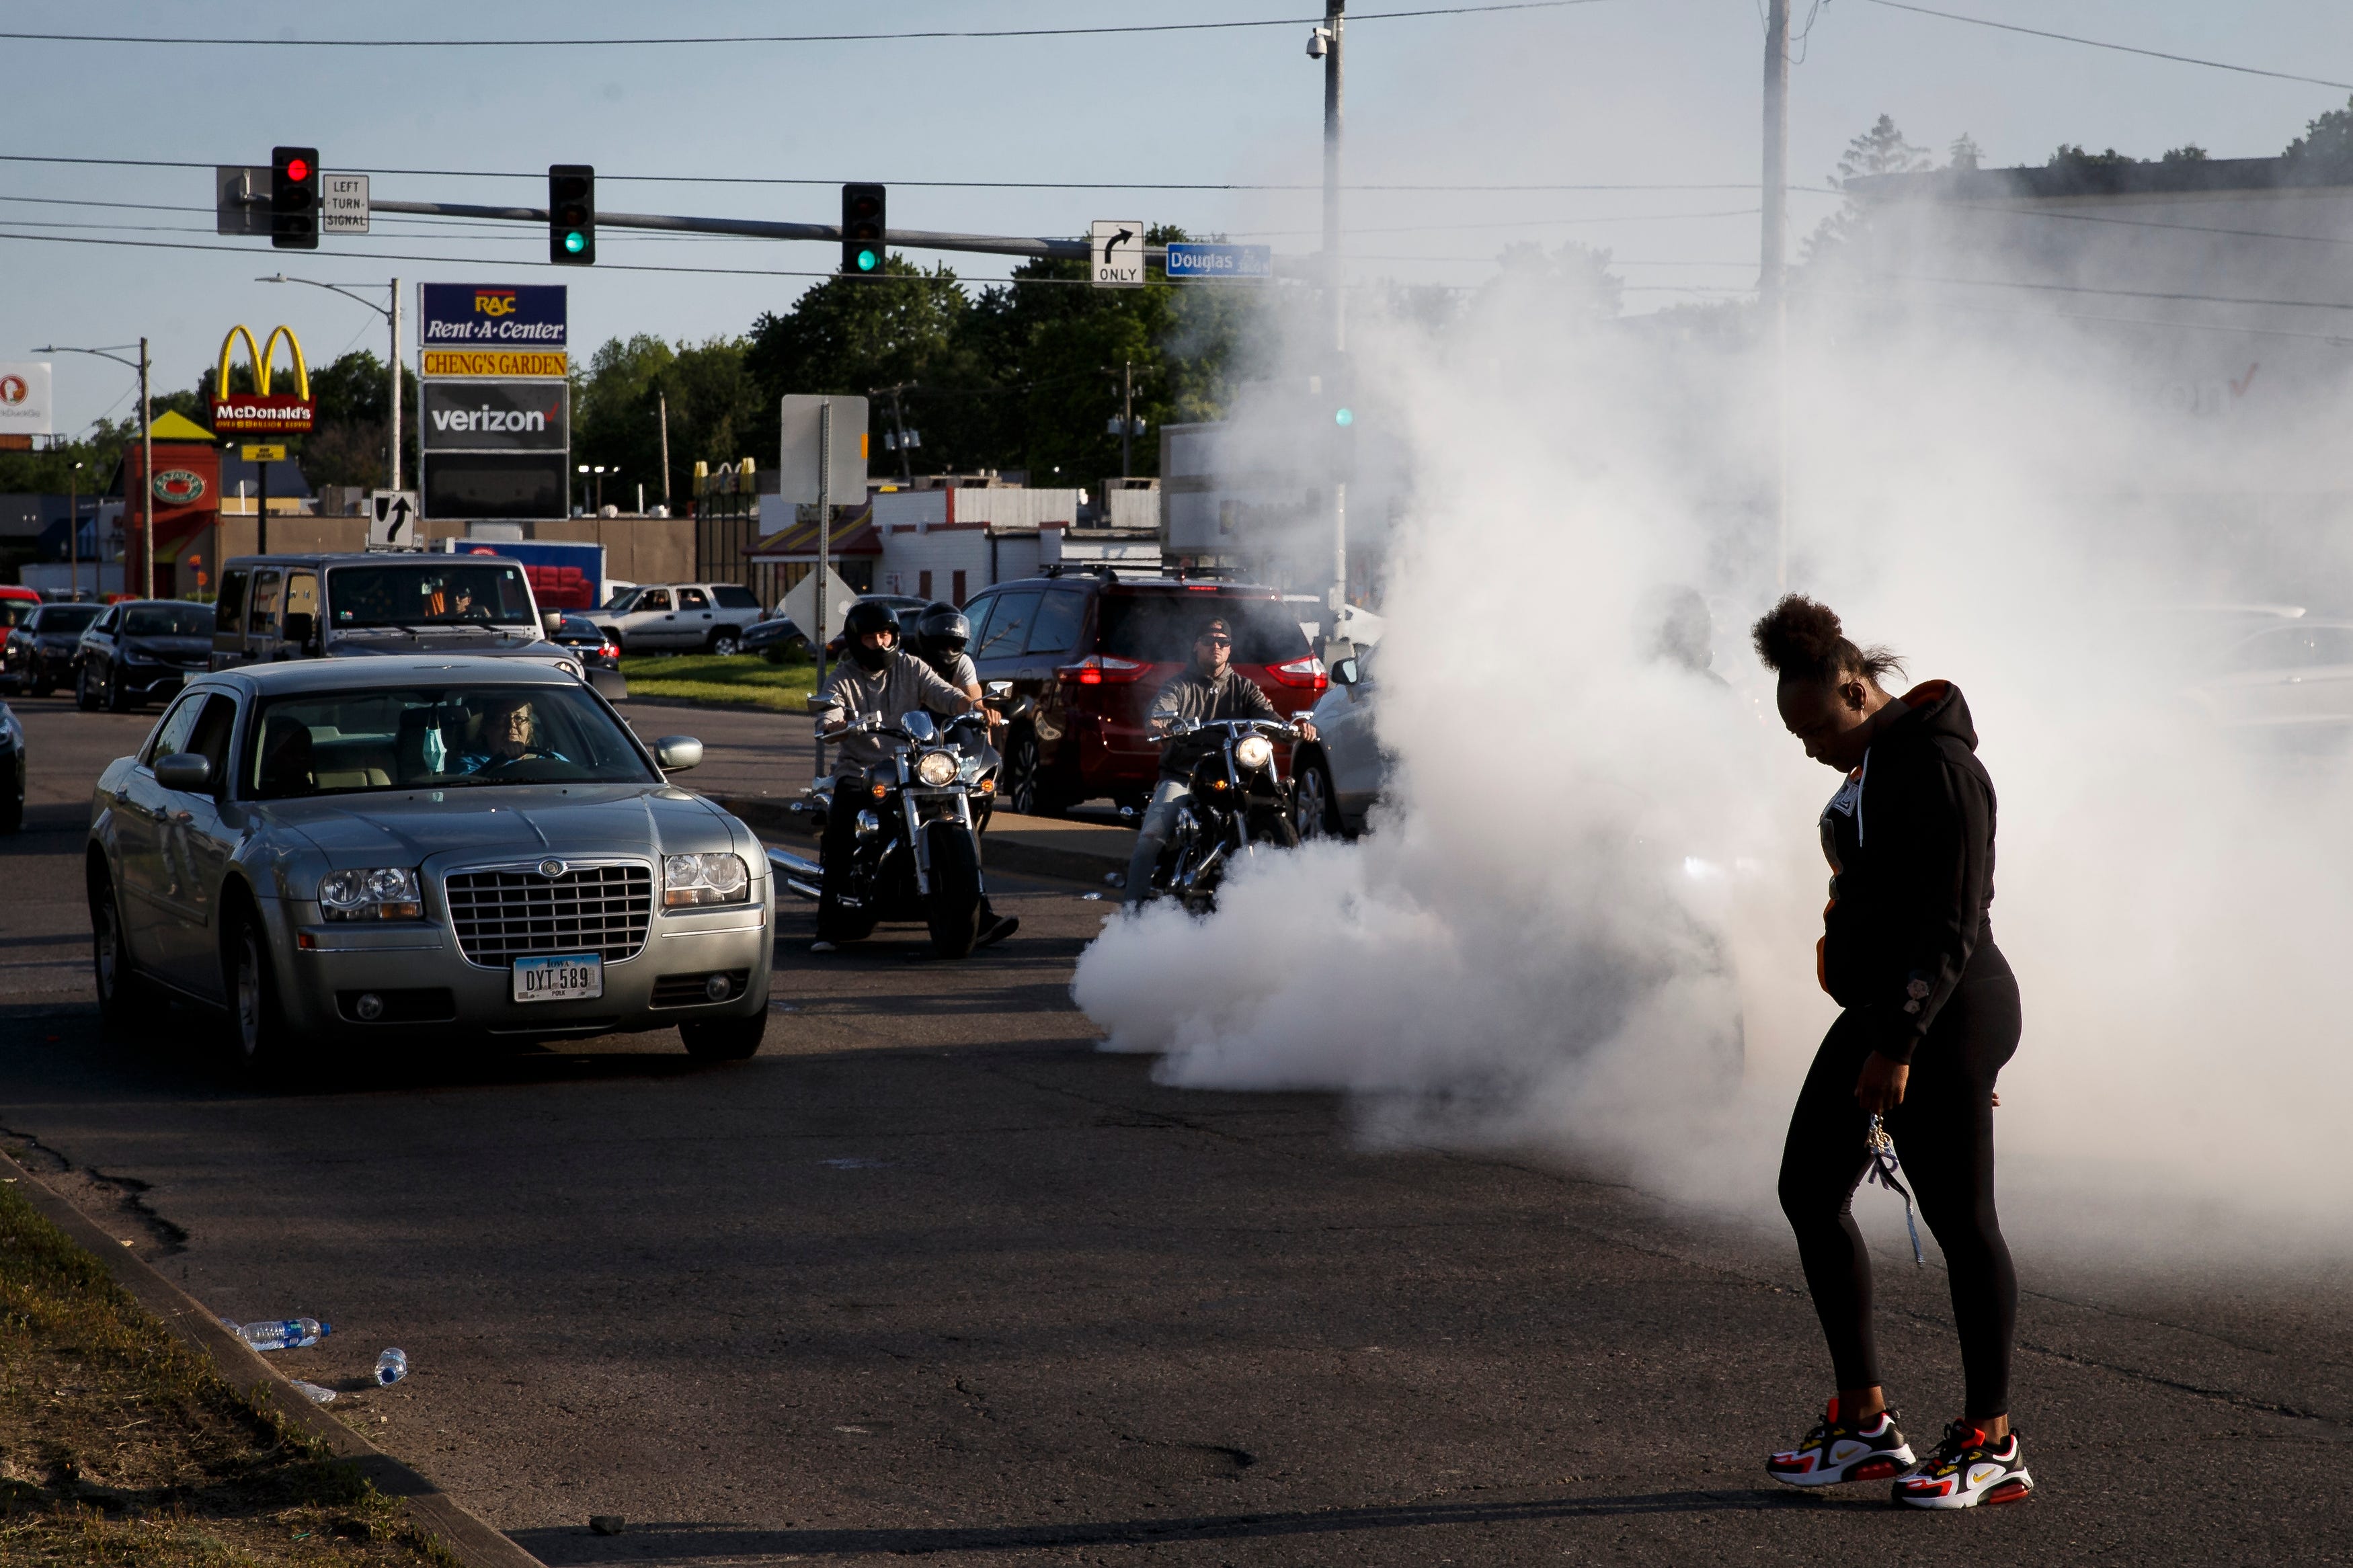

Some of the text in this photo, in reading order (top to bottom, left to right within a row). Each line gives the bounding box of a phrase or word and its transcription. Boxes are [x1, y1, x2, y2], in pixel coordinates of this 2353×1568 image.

[333, 181, 358, 193] LEFT
[332, 198, 360, 209] TURN
[327, 214, 366, 226] SIGNAL
[1170, 252, 1233, 272] Douglas
[1100, 268, 1137, 281] ONLY
[475, 296, 516, 317] RAC
[424, 354, 567, 375] CHENG'S GARDEN
[216, 405, 311, 419] McDonald's
[432, 403, 545, 431] verizon
[526, 966, 588, 991] DYT 589
